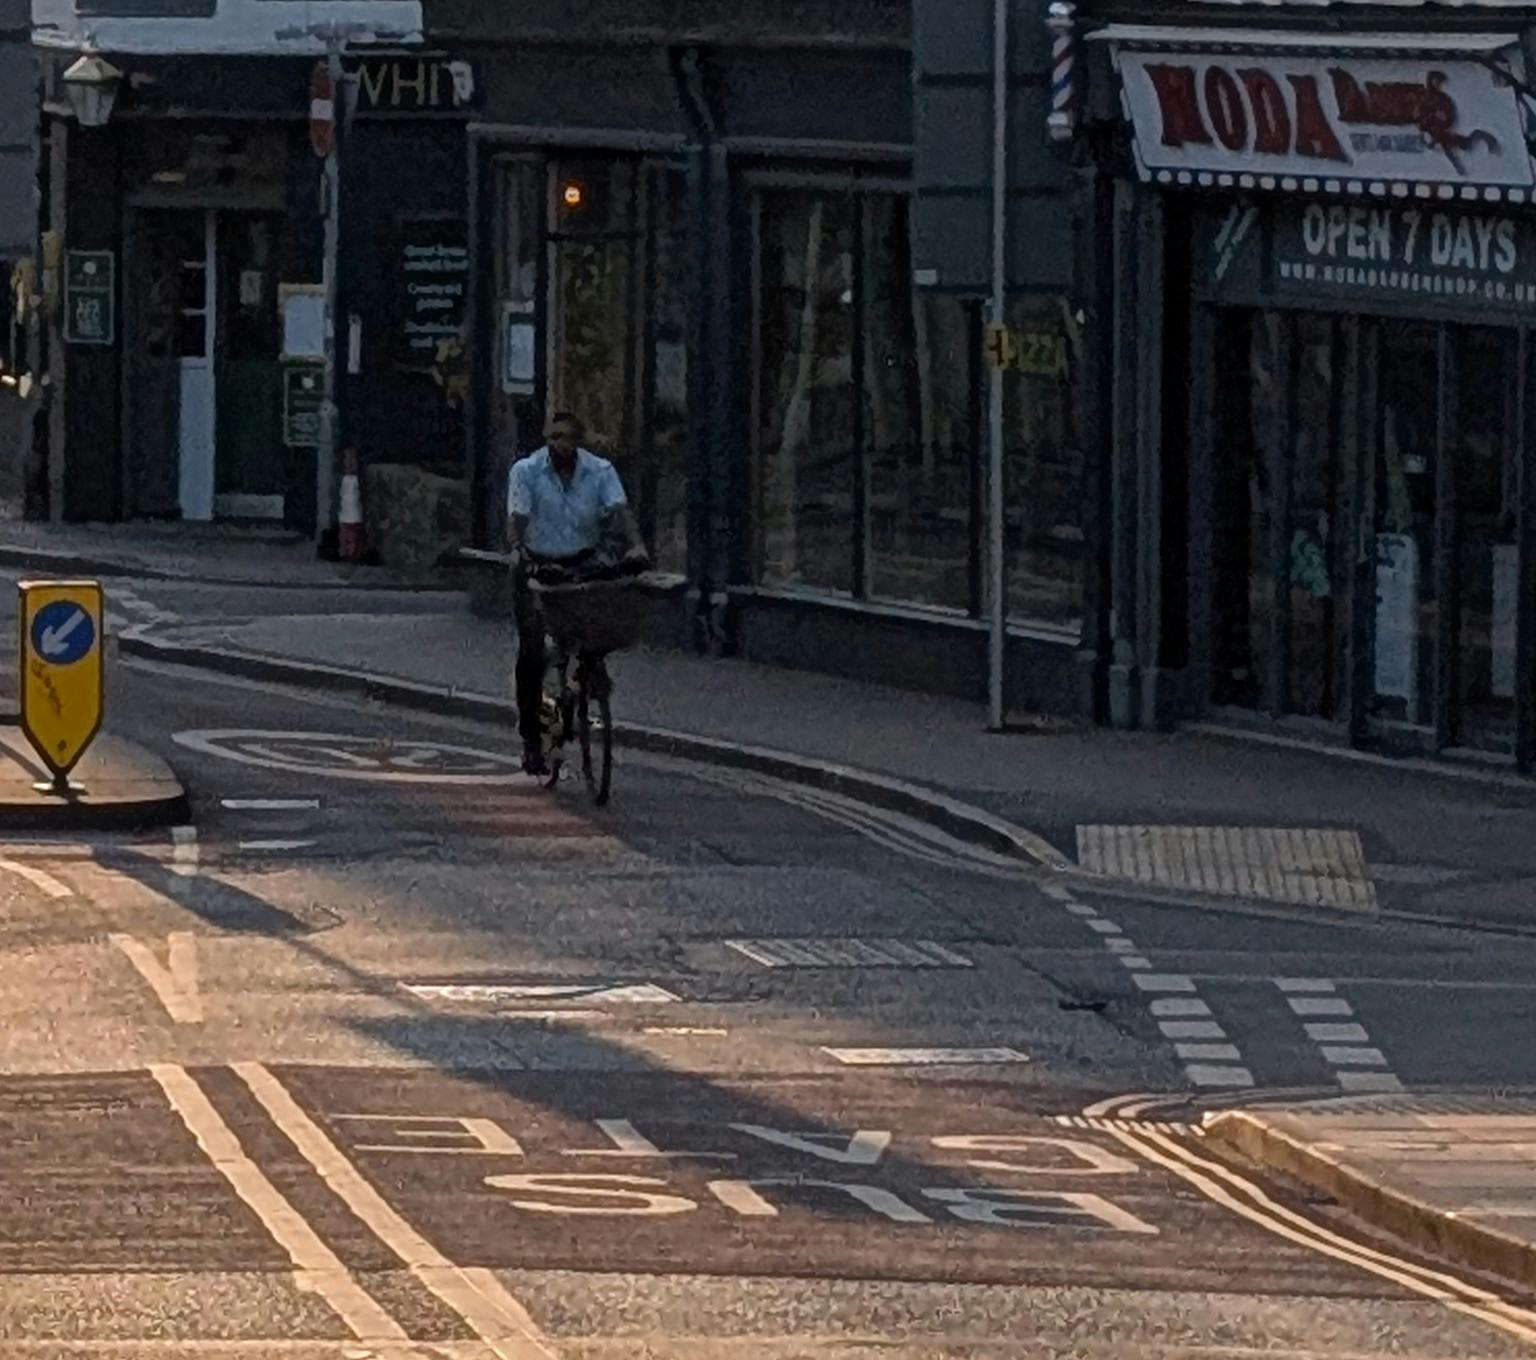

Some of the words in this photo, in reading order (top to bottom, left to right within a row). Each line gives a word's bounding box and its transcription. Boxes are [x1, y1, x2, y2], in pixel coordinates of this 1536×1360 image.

[1302, 204, 1392, 261] OPEN
[1400, 210, 1422, 265] 7
[1430, 213, 1518, 273] DAYS
[333, 1113, 1141, 1177] GATE
[482, 1172, 1161, 1235] BUS
